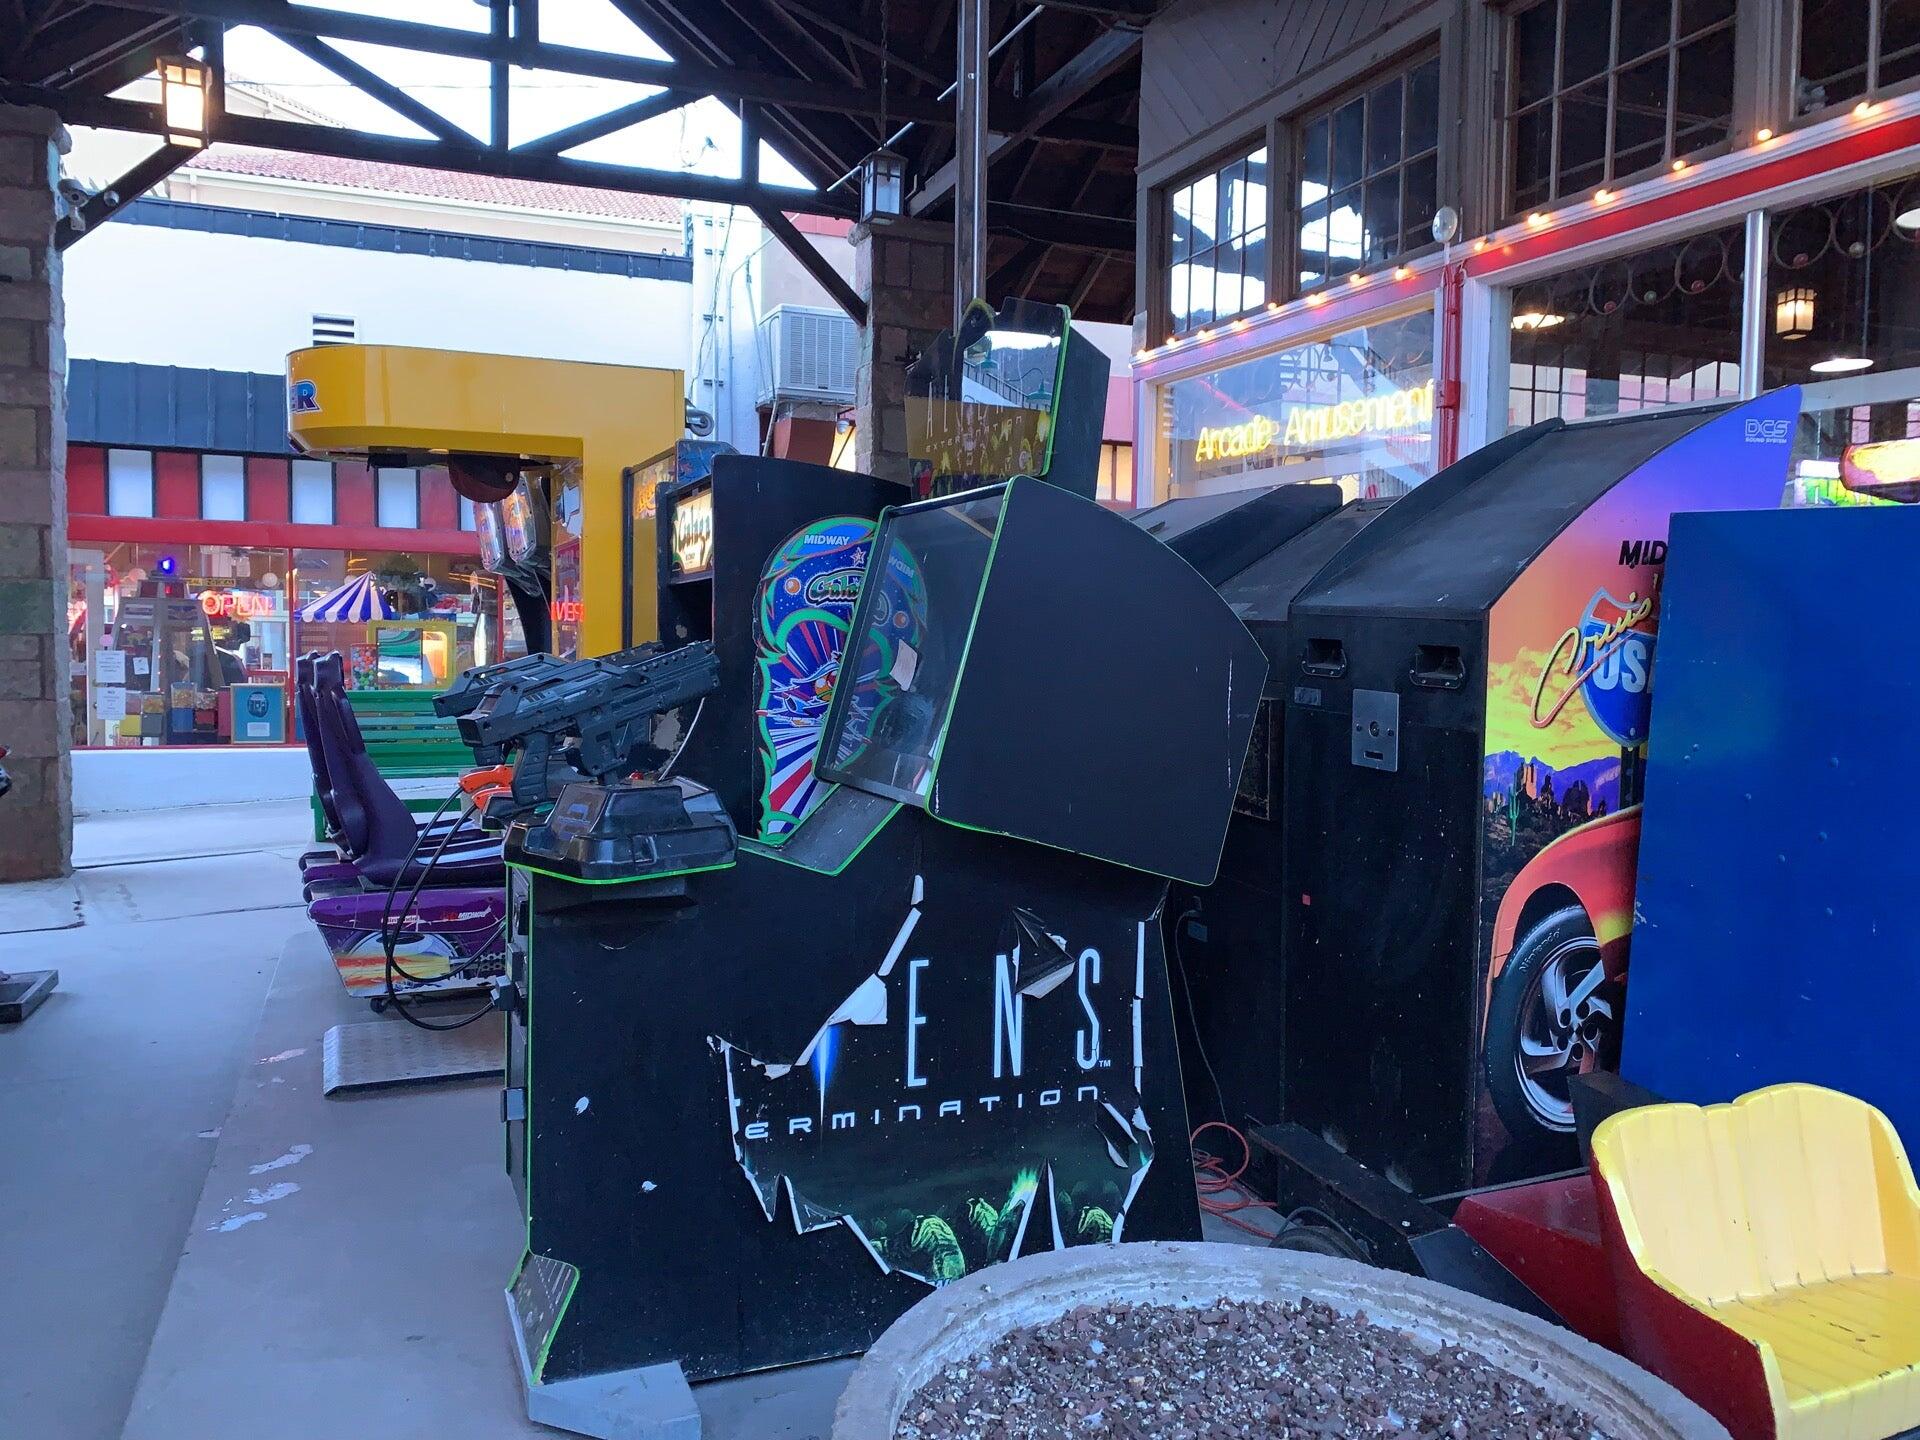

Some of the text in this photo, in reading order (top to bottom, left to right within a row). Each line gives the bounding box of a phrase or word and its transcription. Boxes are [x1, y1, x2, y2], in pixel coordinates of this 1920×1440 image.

[1196, 413, 1272, 462] Arcade
[1744, 418, 1791, 437] DCS
[803, 534, 850, 546] MIDWAY
[1619, 540, 1667, 566] MID
[202, 591, 270, 616] OPEN
[1593, 637, 1655, 693] US
[1518, 927, 1561, 974] Nintendo
